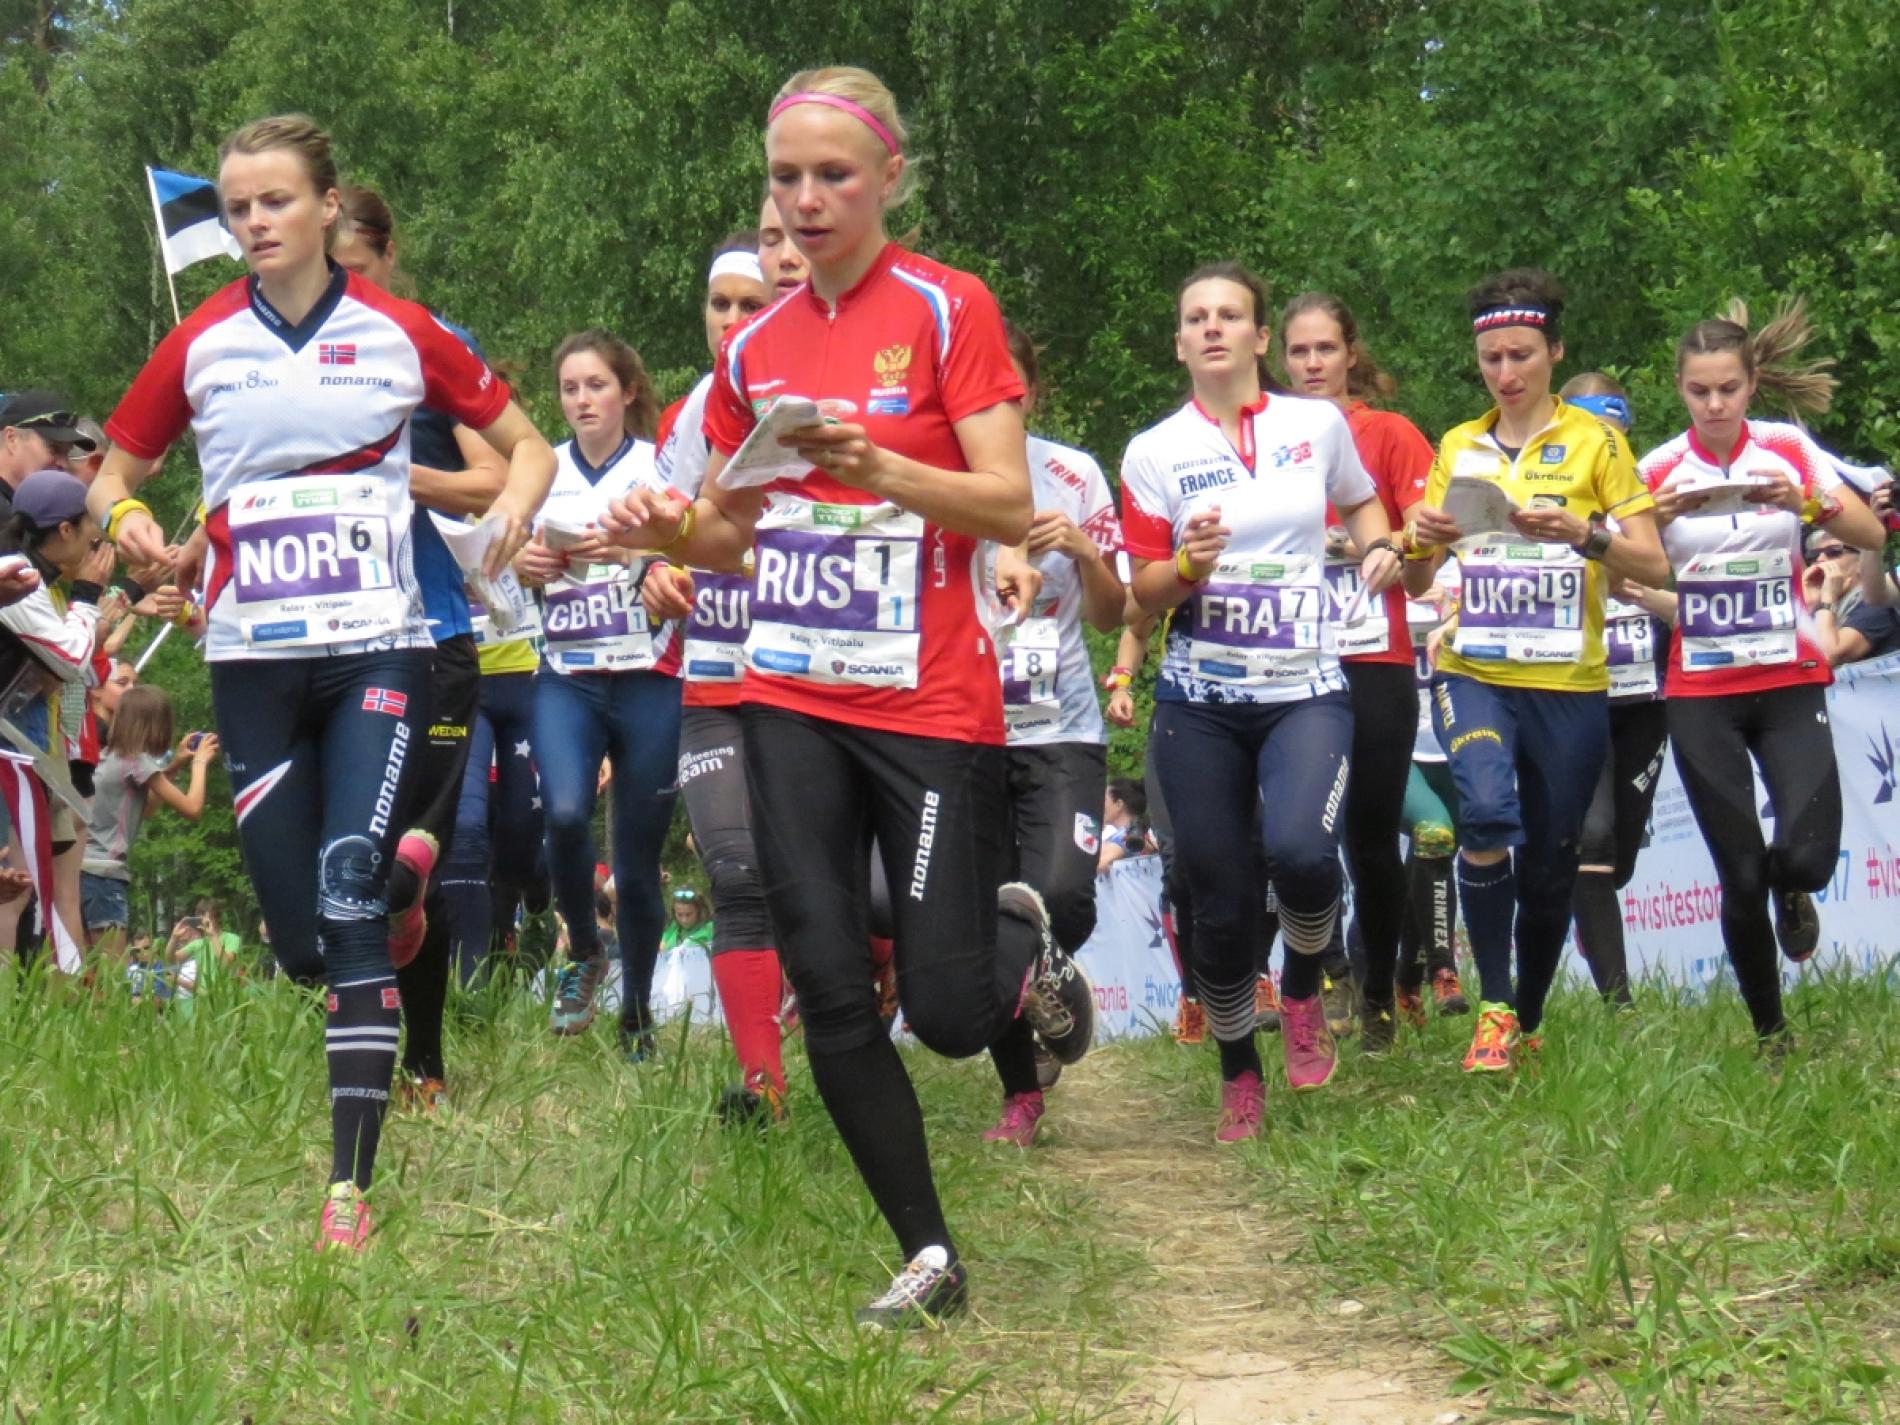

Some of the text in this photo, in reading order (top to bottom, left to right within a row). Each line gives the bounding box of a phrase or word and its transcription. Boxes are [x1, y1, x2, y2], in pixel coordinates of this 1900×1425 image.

[320, 376, 393, 388] noname
[1180, 467, 1237, 494] FRANCE
[1525, 471, 1574, 482] Ukraine
[239, 521, 371, 587] NOR 6
[369, 559, 381, 583] 1
[757, 545, 891, 609] RUS 1
[1465, 571, 1577, 615] UKR 19
[1685, 581, 1787, 627] POL 16
[547, 595, 612, 632] GBR
[632, 612, 641, 630] 1
[694, 587, 750, 629] SUI
[890, 596, 904, 627] 1
[1201, 591, 1306, 637] FRA 7
[1563, 605, 1572, 625] 1
[1302, 624, 1311, 644] 1
[1619, 618, 1648, 641] 13
[848, 664, 904, 675] SCANIA
[1026, 652, 1043, 677] 8
[1038, 679, 1046, 698] 1
[368, 721, 411, 839] noname
[680, 758, 723, 783] eam
[910, 790, 941, 901] noname
[1433, 880, 1449, 949] TRIMTEX
